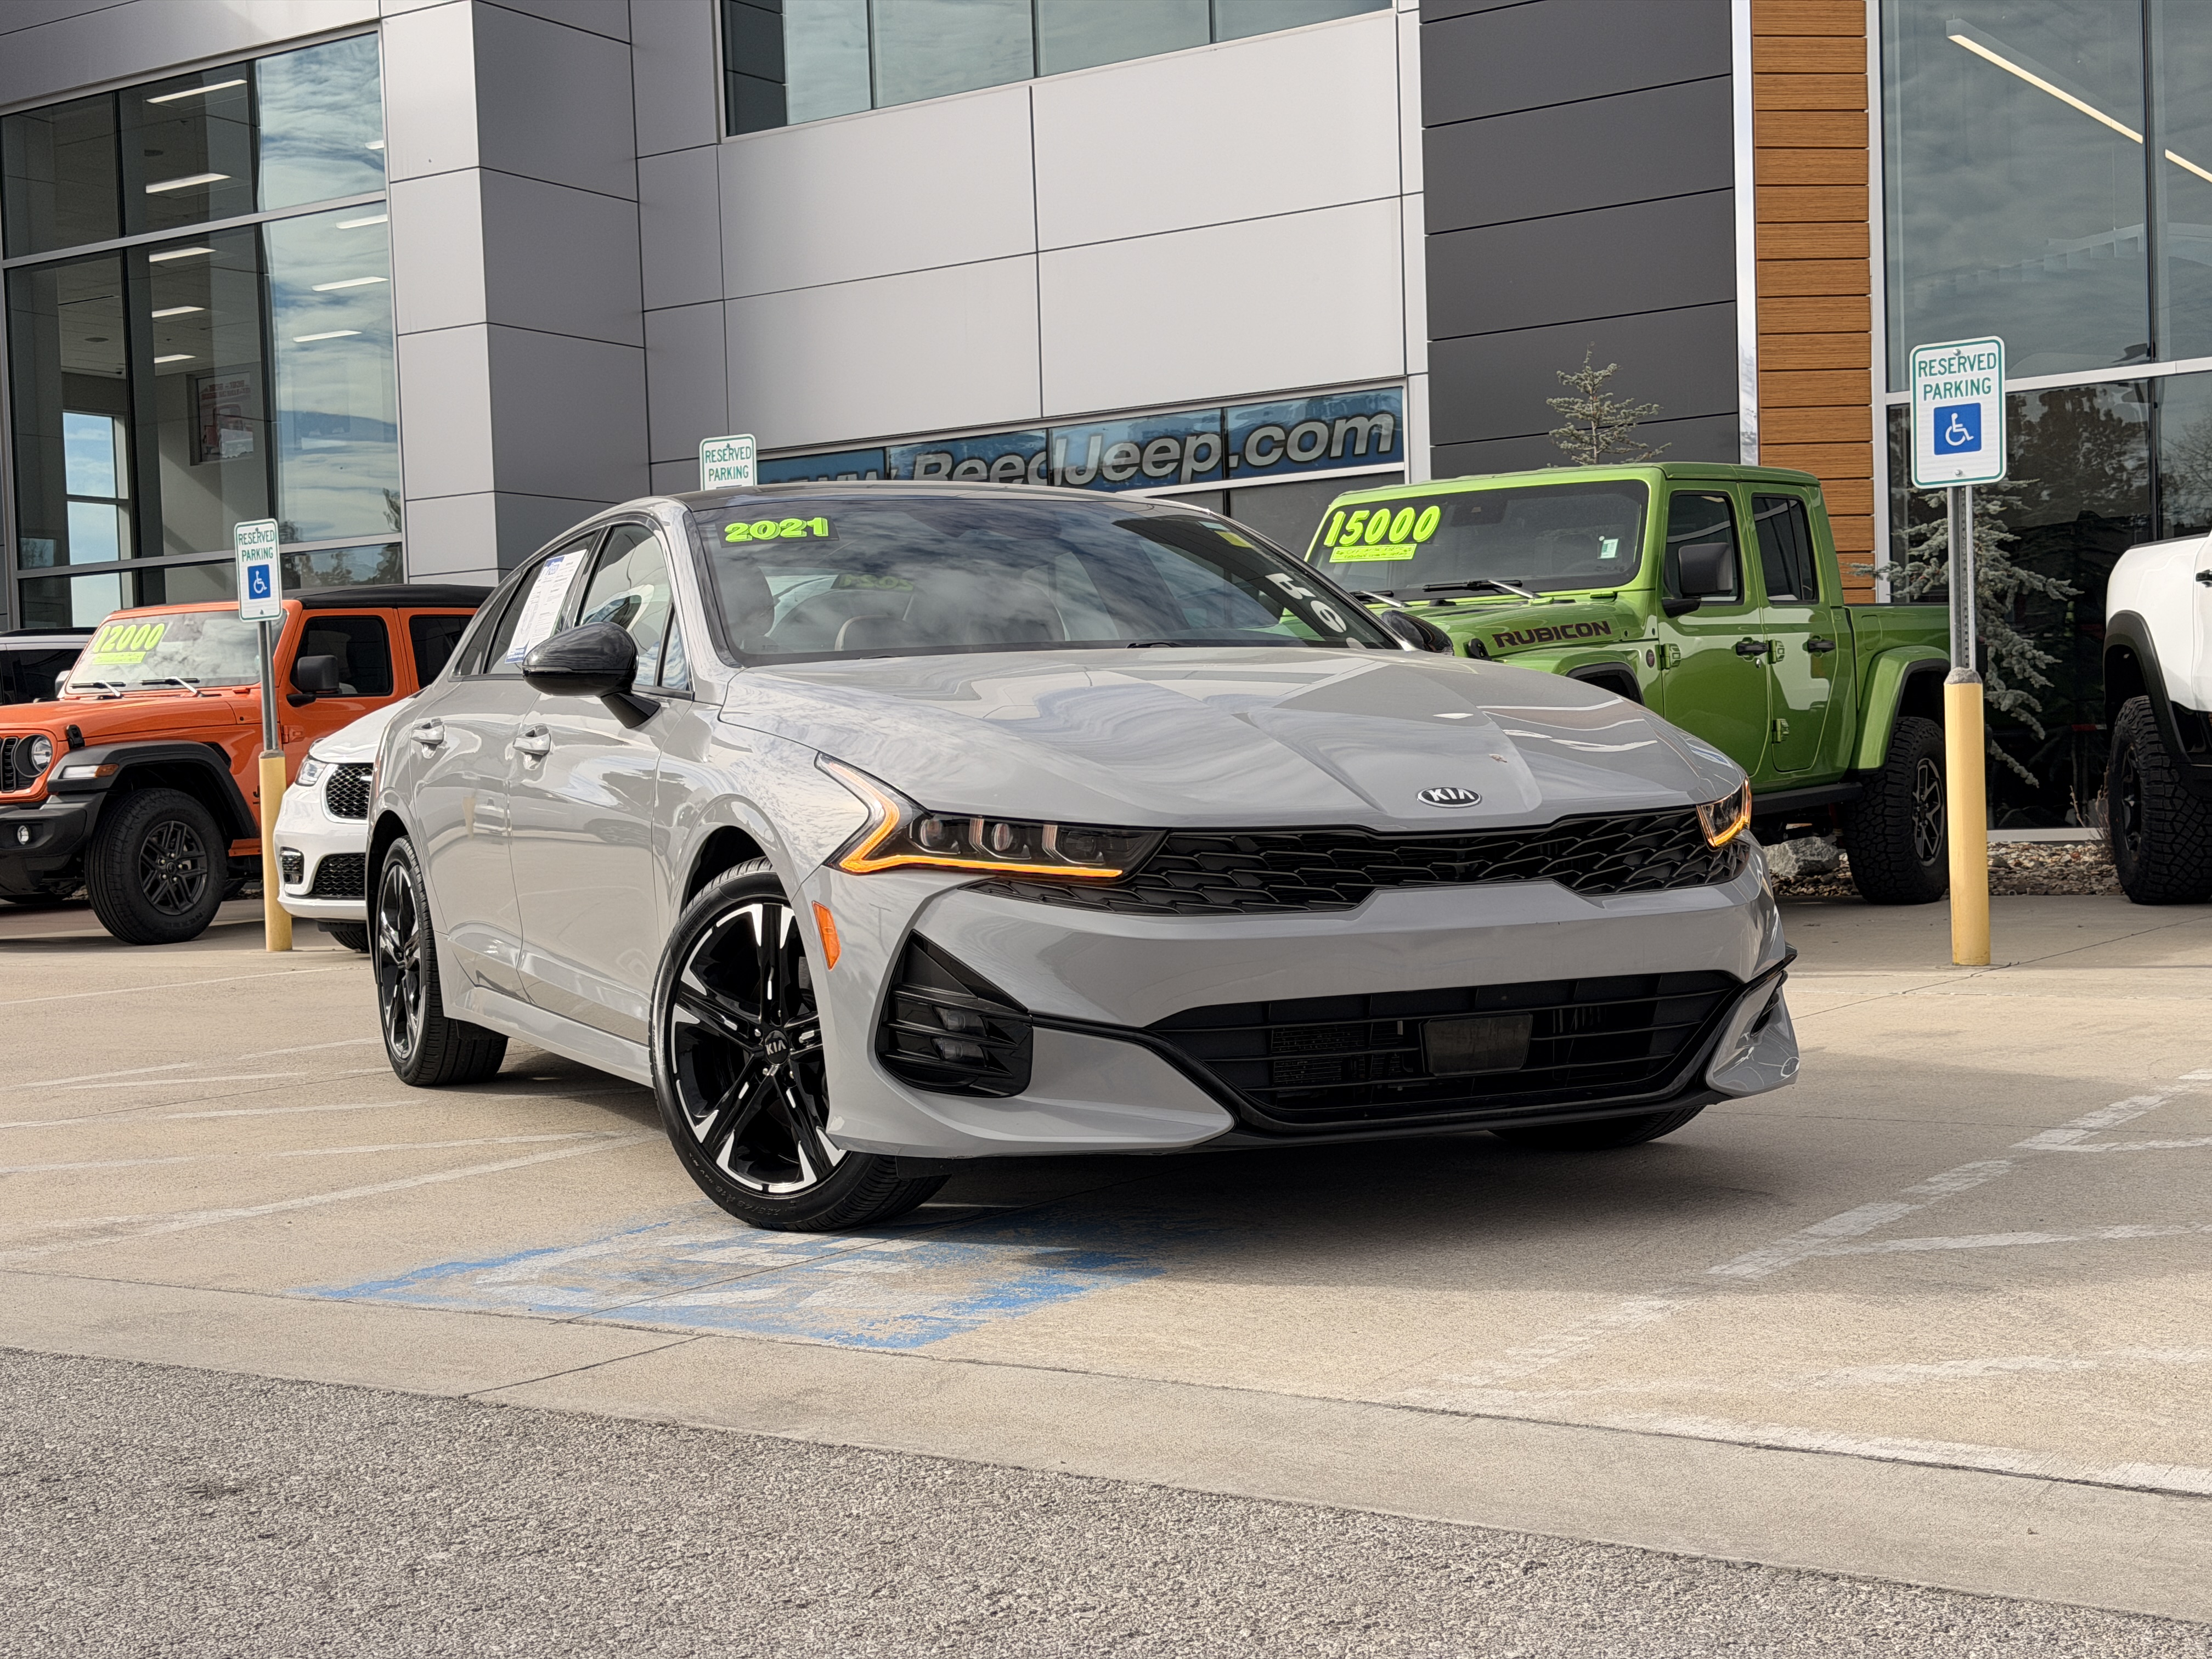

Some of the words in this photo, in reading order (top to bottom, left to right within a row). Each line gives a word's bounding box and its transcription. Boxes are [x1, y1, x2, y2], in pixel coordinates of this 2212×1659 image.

[1918, 352, 1997, 378] RESERVED
[1923, 377, 1991, 401] PARKING
[705, 446, 752, 464] RESERVED
[708, 465, 749, 482] PARKING
[724, 517, 829, 543] 2021
[1324, 505, 1441, 546] 15000
[238, 529, 275, 545] RESERVED
[241, 546, 274, 562] PARKING
[92, 623, 165, 653] 12000
[1491, 620, 1612, 648] RUBICON
[1426, 788, 1475, 801] KIA
[765, 1040, 787, 1056] KIA
